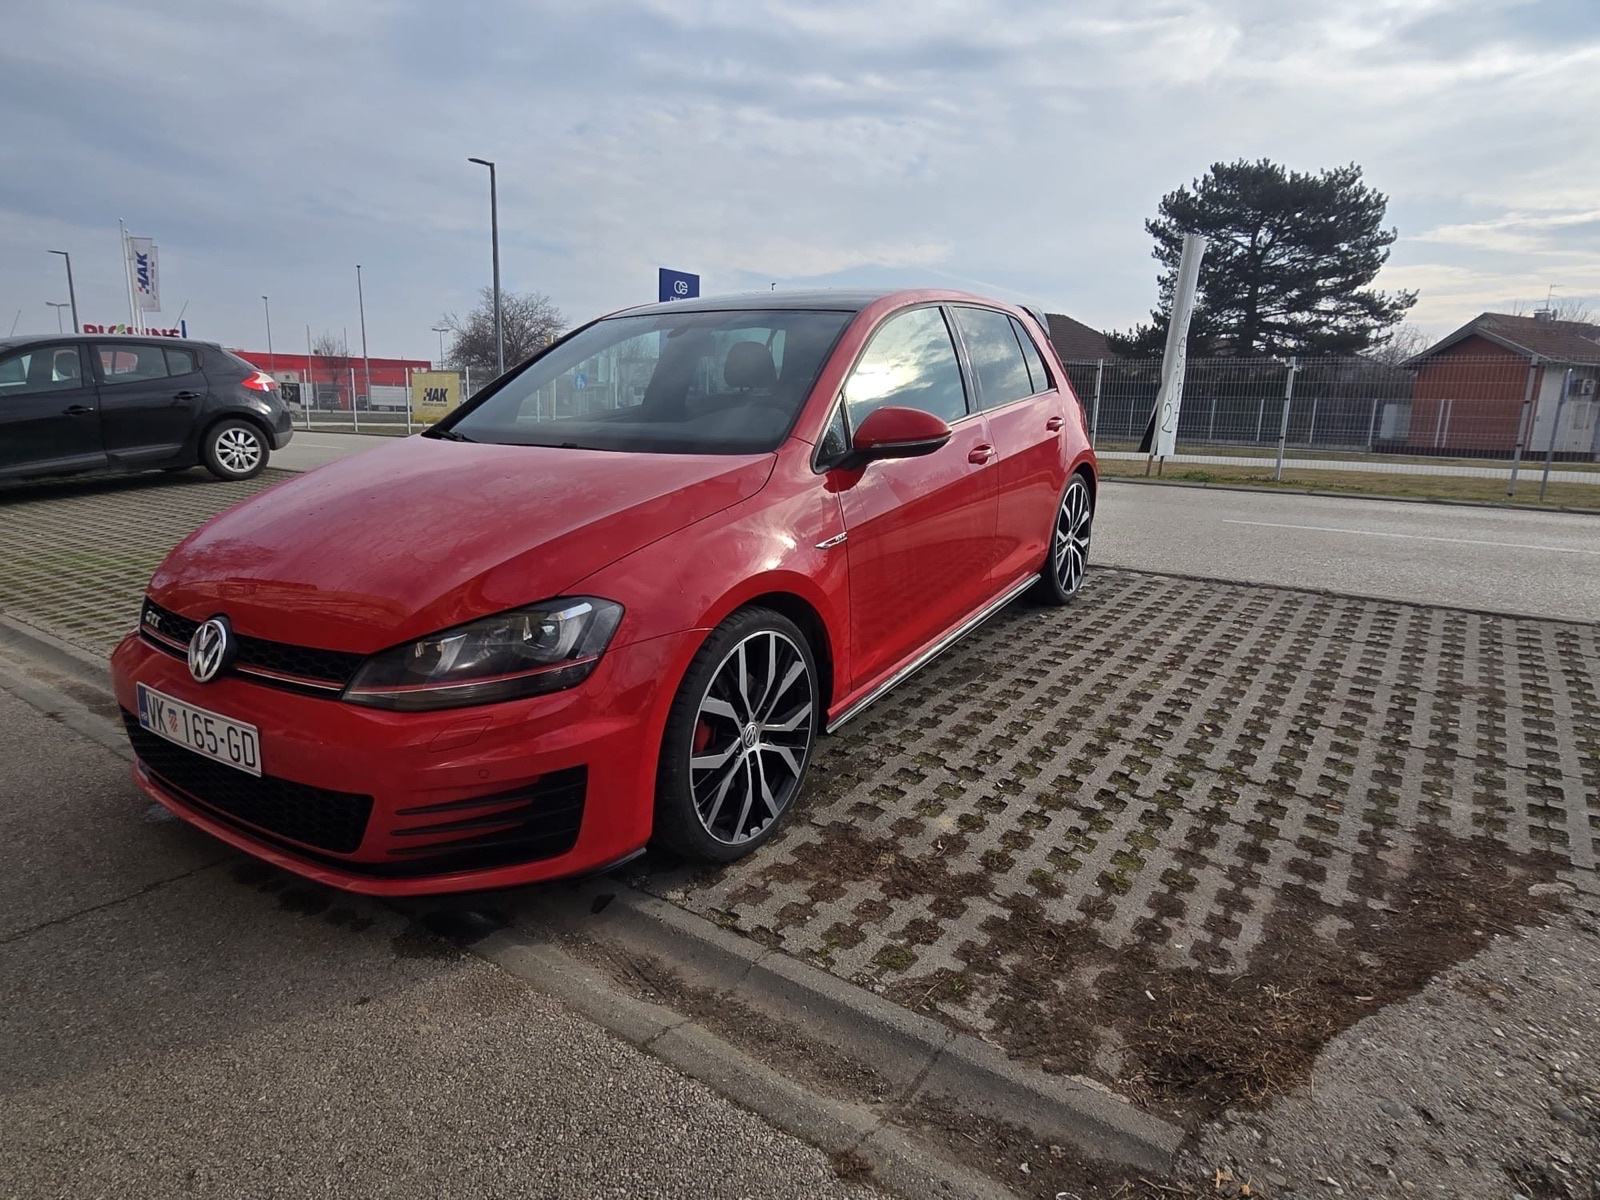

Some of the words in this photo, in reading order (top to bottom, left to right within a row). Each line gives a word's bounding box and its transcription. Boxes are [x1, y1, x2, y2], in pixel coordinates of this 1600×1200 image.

[135, 251, 149, 294] HAK
[423, 387, 448, 402] HAK
[147, 694, 168, 734] VK
[182, 709, 256, 768] 165-GD
